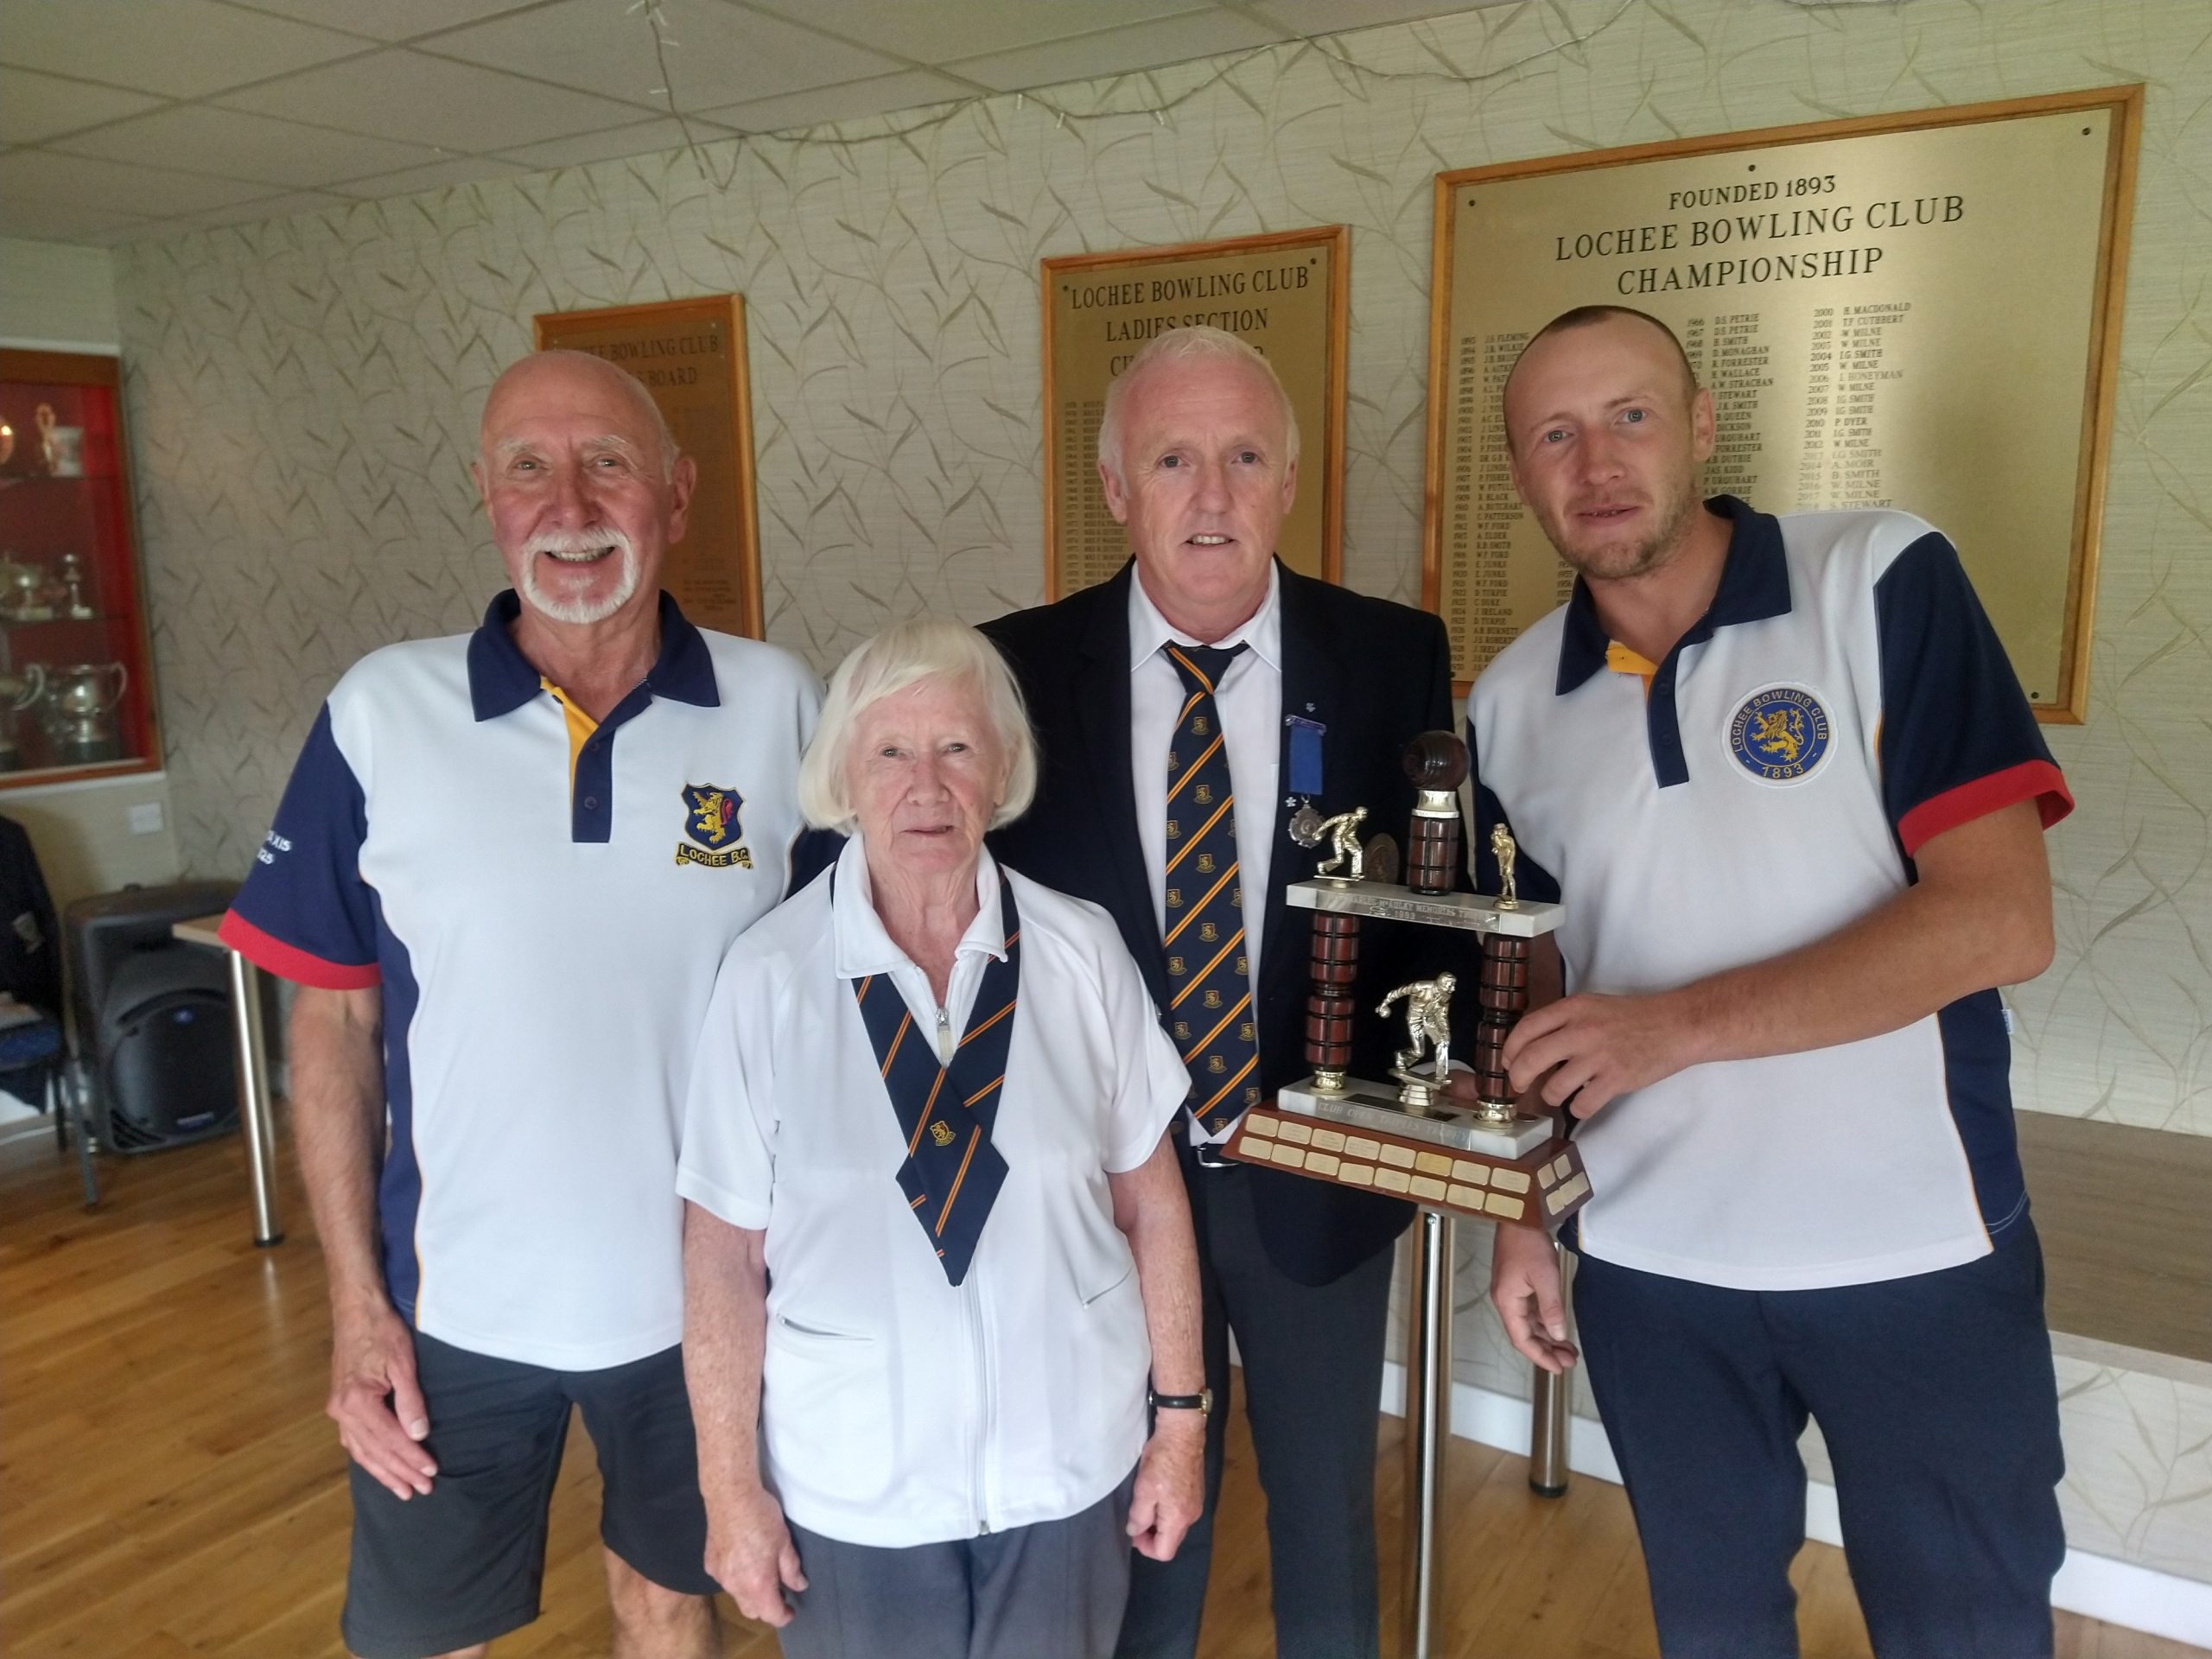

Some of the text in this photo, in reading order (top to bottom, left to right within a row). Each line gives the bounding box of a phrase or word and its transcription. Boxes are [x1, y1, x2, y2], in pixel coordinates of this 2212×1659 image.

[1668, 175, 1837, 210] FOUNDED 1893
[1555, 195, 1966, 262] LOCHEE BOWLING CLUB
[1617, 247, 1885, 296] CHAMPIONSHIP
[1071, 266, 1309, 310] LOCHEE BOWLING CLUB
[609, 338, 677, 361] BOWLING
[681, 334, 719, 354] CLUB
[649, 367, 698, 387] BOARD
[1732, 690, 1827, 753] LOCHEE BOWLING CLUB
[1762, 763, 1804, 779] 1893
[680, 844, 728, 866] LOCHEE
[1318, 1102, 1343, 1113] CLUB
